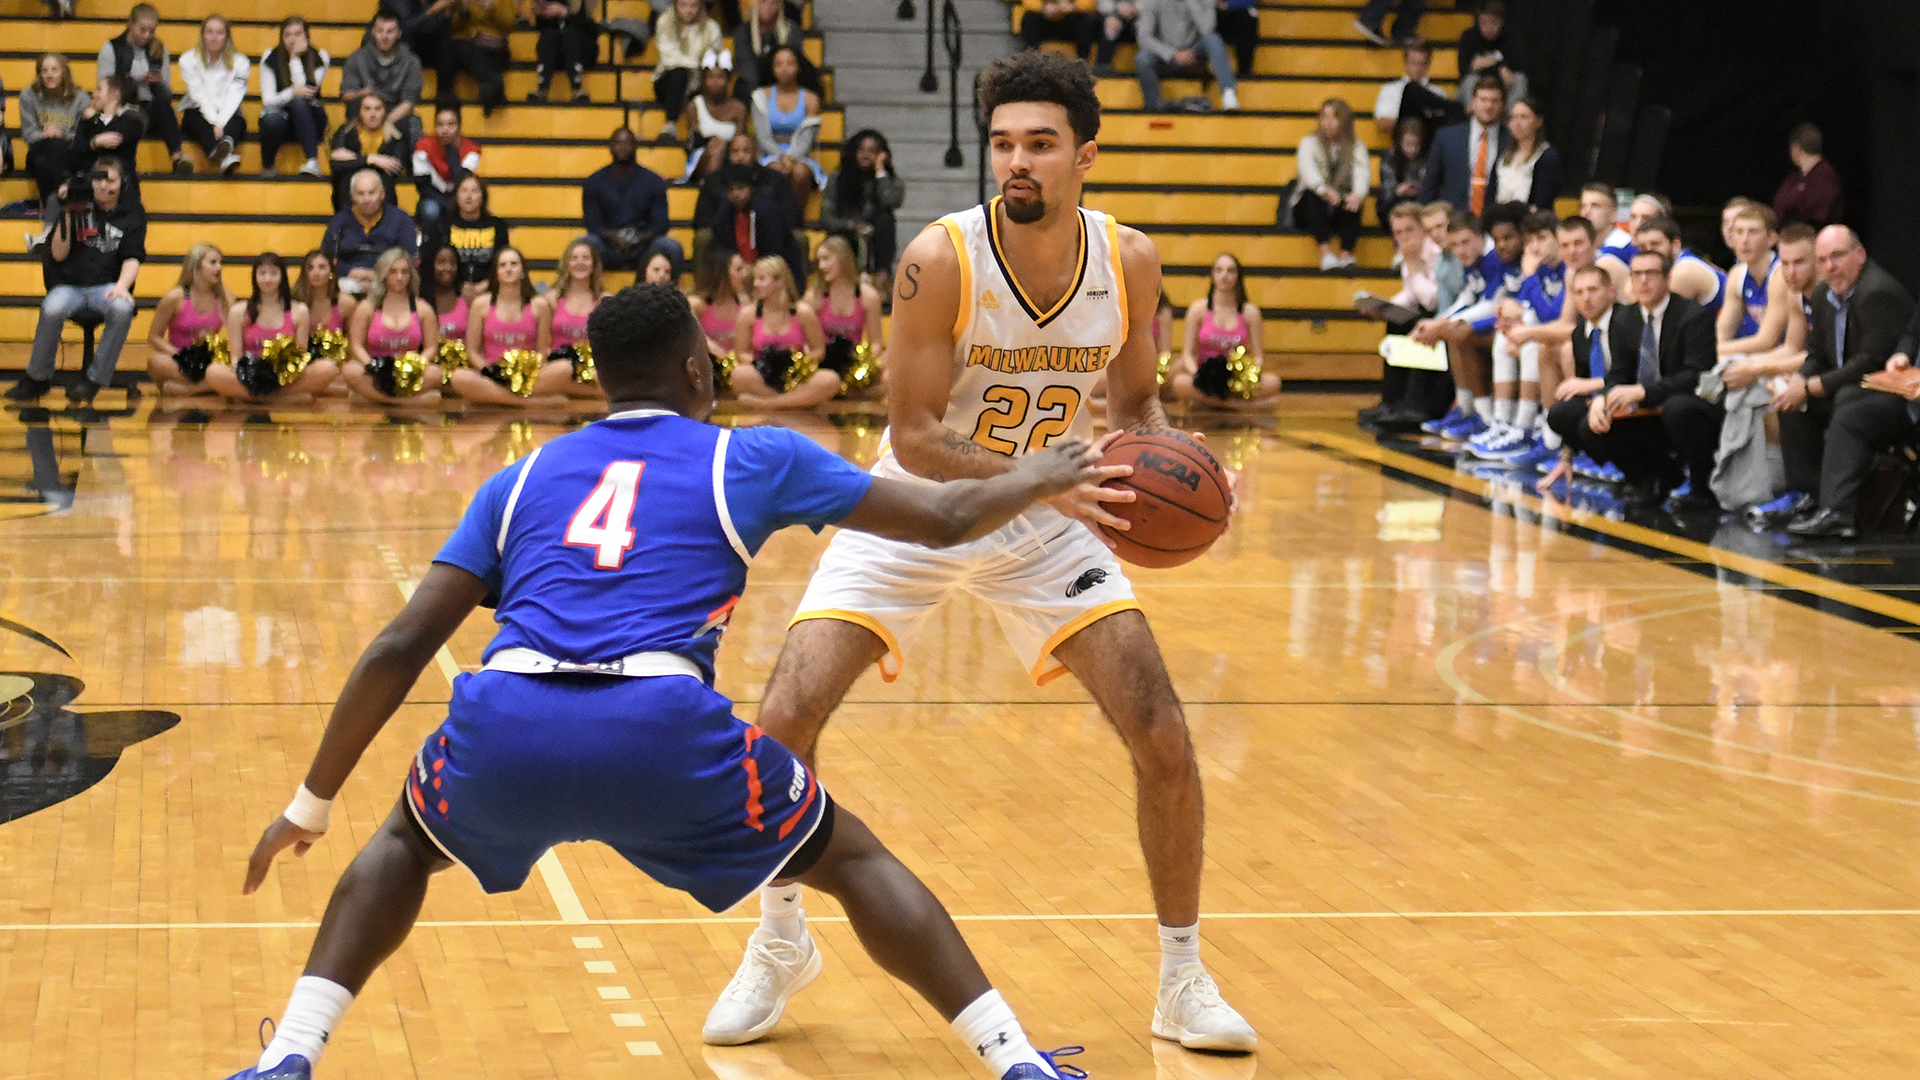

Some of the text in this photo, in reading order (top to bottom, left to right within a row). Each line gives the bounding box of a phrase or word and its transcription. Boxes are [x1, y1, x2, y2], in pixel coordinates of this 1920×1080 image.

[966, 344, 1111, 374] MILWAUKEE
[970, 384, 1081, 456] 22
[1135, 451, 1201, 492] NCAA
[563, 460, 646, 571] 4
